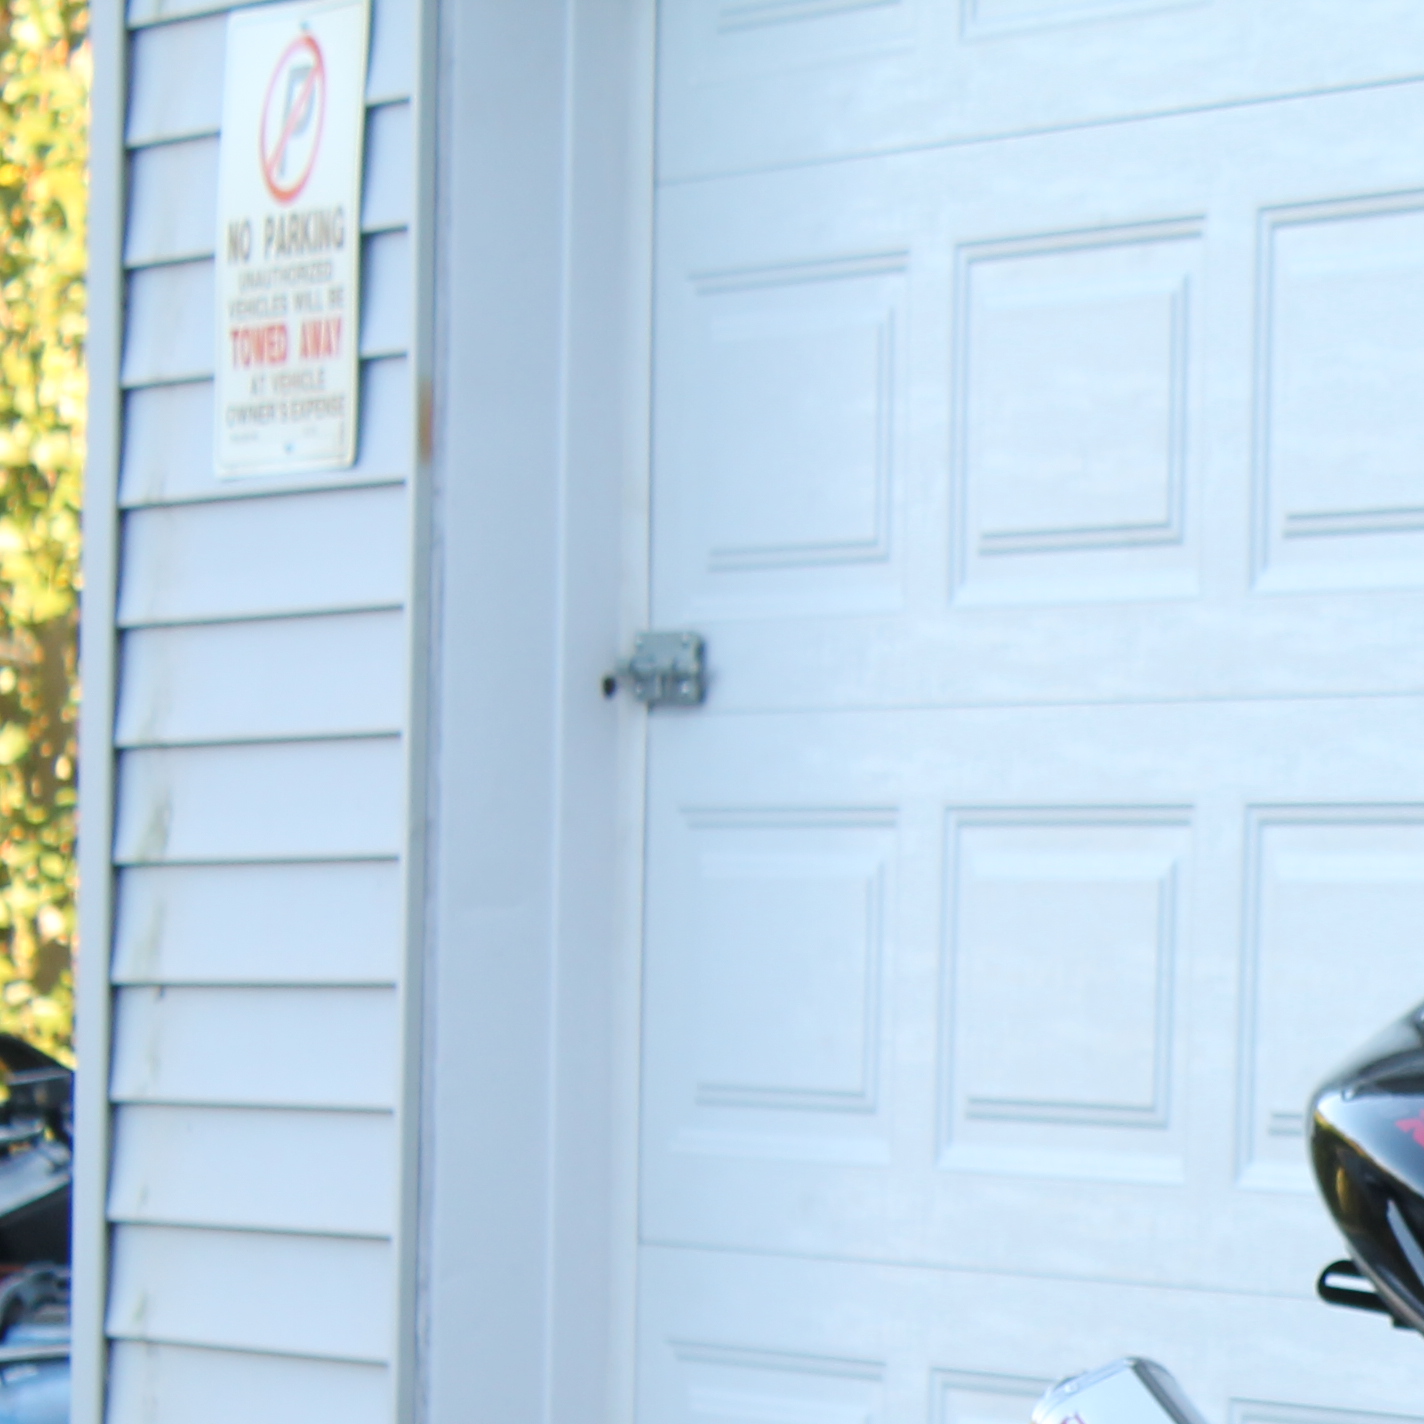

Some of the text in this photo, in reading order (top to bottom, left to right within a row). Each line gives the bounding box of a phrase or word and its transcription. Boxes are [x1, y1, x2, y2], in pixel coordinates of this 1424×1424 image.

[227, 206, 345, 264] NO PARKING
[230, 317, 342, 370] TOWED AWAY
